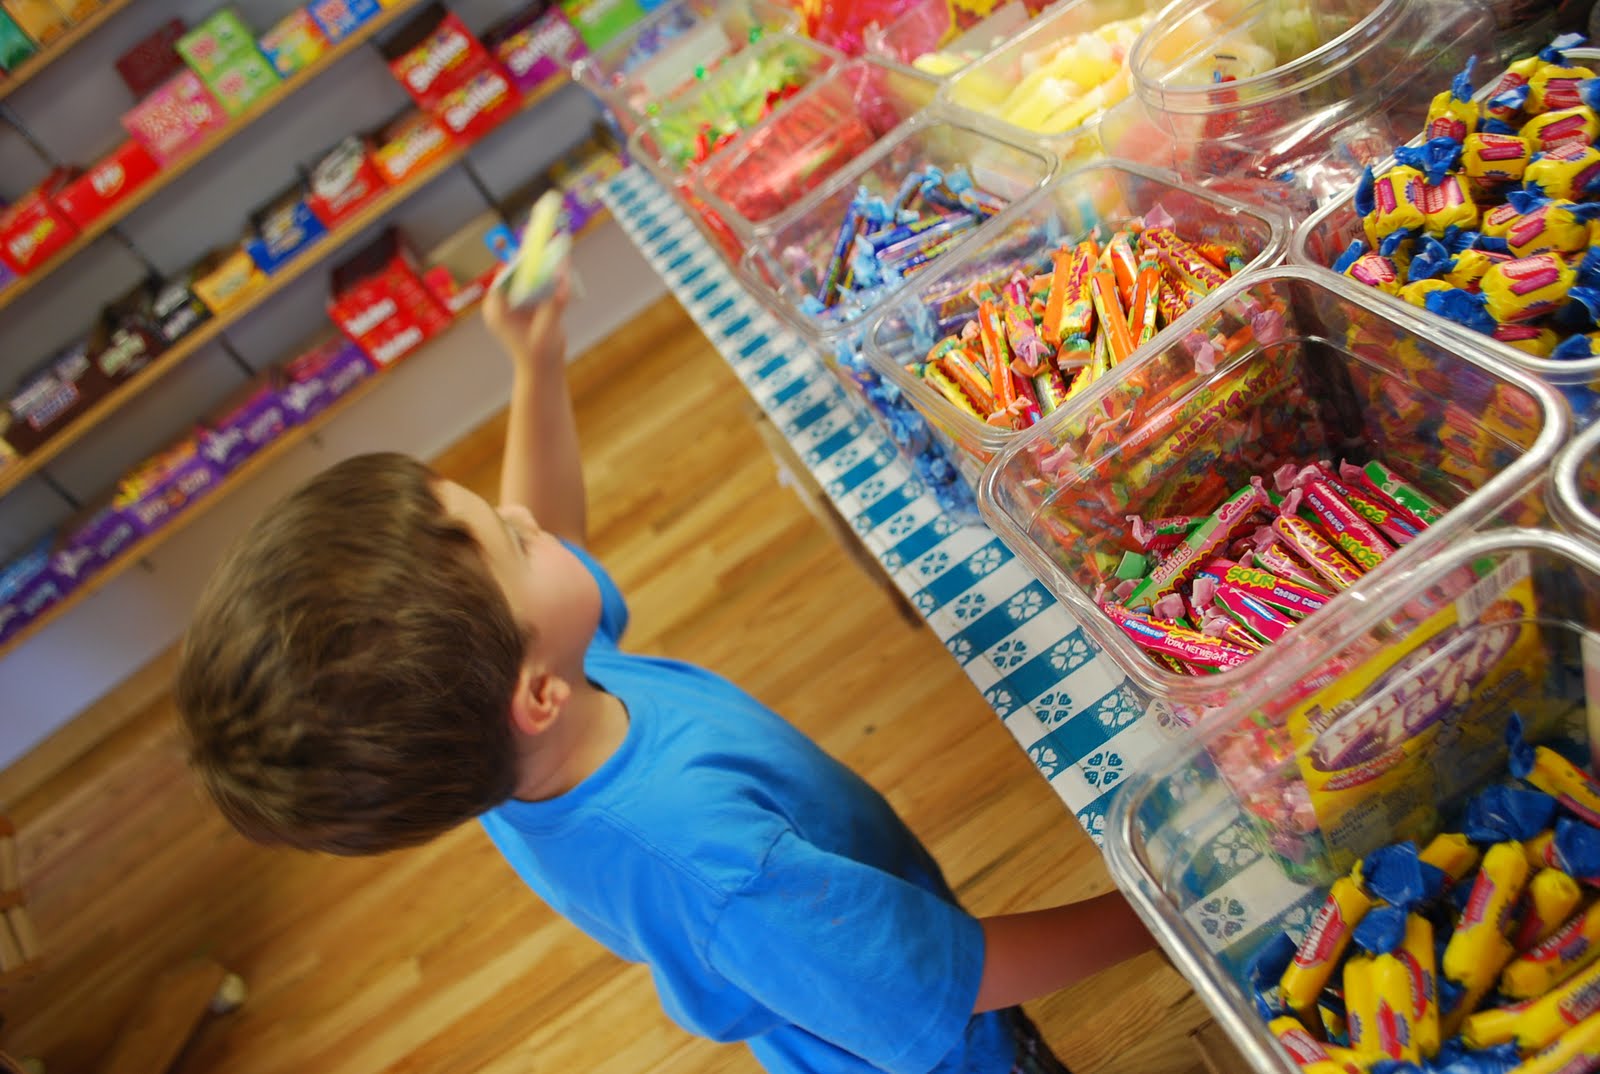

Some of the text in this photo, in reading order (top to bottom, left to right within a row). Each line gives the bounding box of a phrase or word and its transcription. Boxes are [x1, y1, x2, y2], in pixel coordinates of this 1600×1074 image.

[1340, 532, 1382, 569] SOUR
[1226, 566, 1325, 609] SOUR Chewy Cand
[1164, 636, 1185, 650] TOTAL
[1185, 643, 1201, 655] NET
